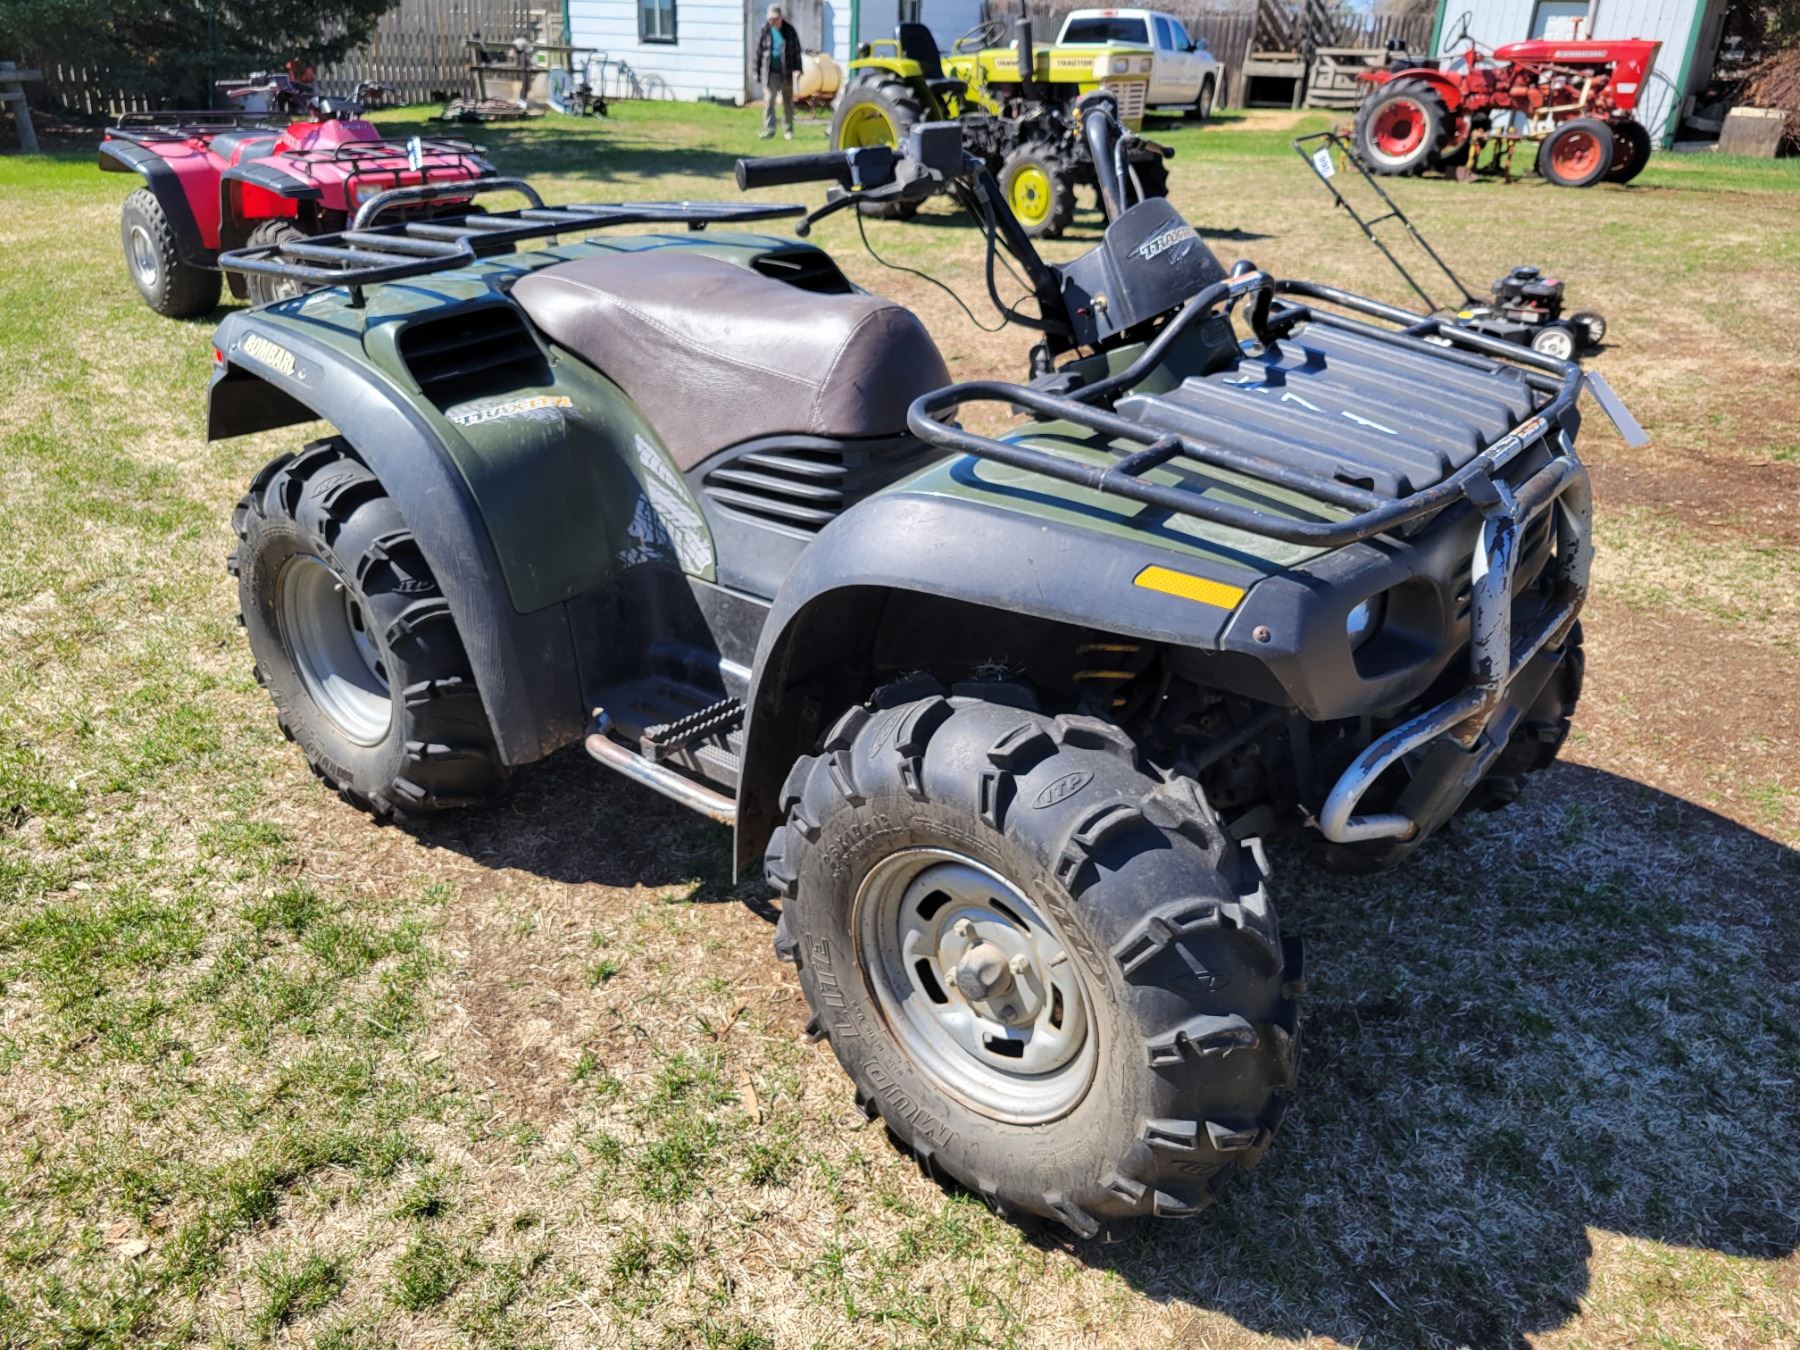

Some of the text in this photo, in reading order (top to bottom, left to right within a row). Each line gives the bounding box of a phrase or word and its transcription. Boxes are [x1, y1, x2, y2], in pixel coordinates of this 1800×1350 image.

[1046, 774, 1083, 804] ITP
[806, 933, 955, 1149] MUD LITE
